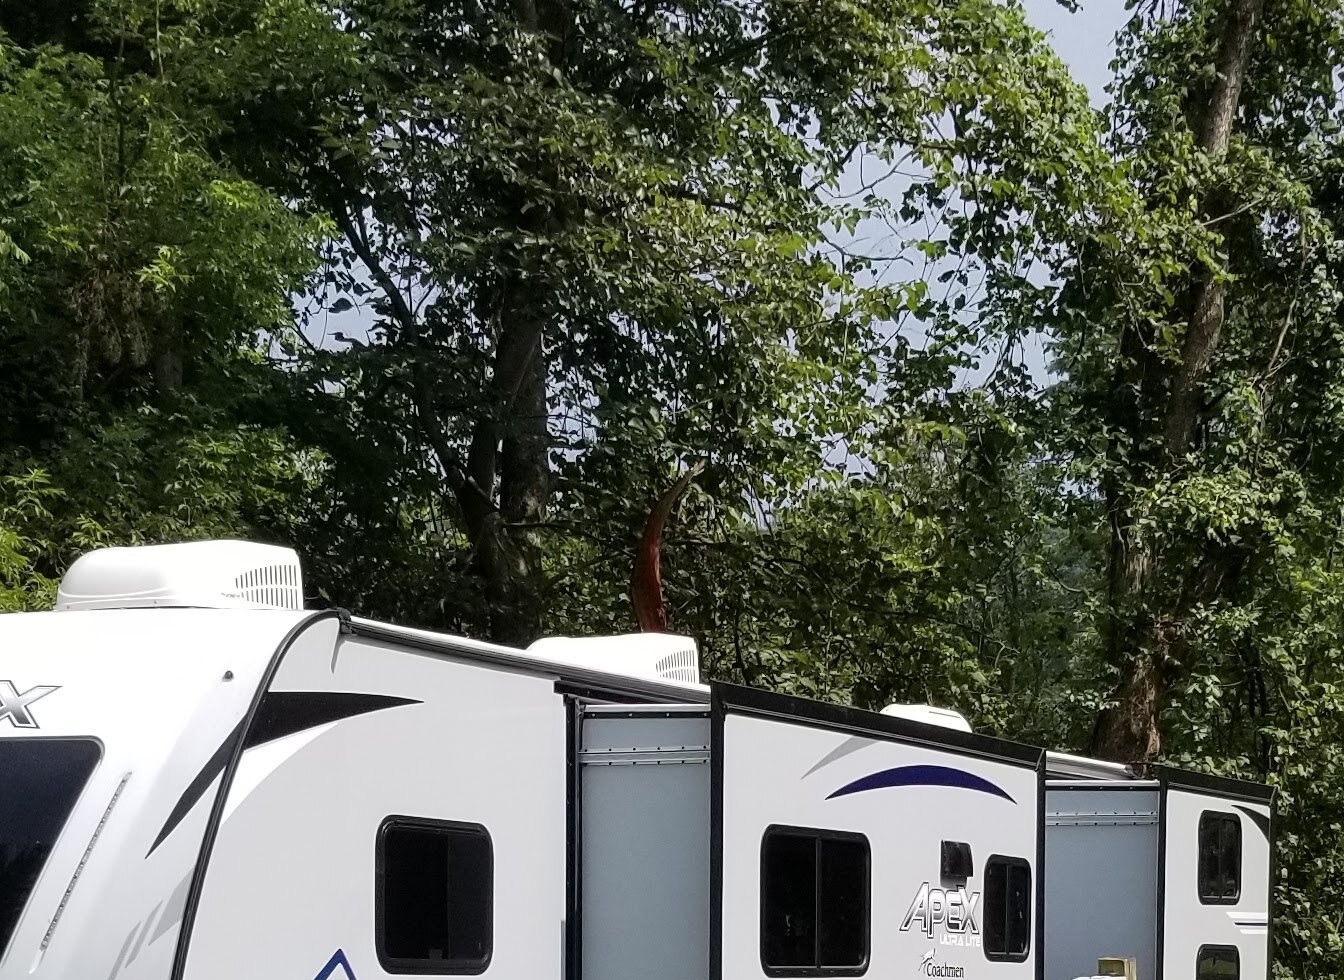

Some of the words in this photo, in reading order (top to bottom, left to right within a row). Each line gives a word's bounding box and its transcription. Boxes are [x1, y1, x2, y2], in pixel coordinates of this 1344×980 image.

[899, 881, 980, 939] APEX
[939, 934, 963, 946] ULTRA
[965, 935, 981, 947] LITE
[926, 962, 964, 978] Coachmen
